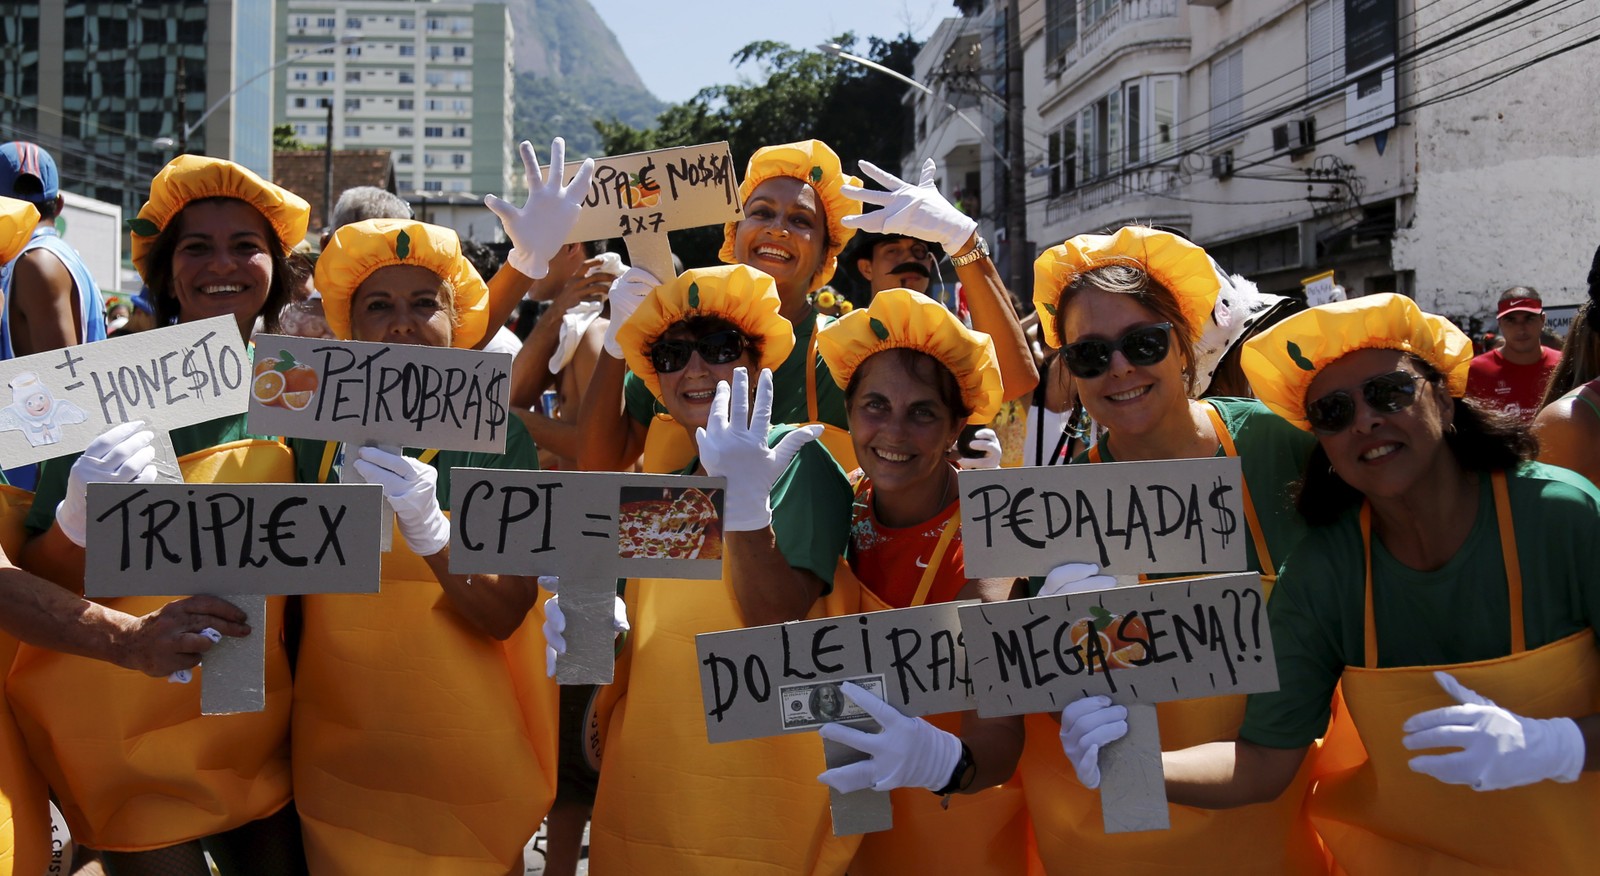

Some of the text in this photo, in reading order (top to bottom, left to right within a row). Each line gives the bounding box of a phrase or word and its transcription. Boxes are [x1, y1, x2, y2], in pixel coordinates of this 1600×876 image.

[460, 480, 563, 553] CPI
[992, 614, 1117, 693] MEGA
[49, 839, 62, 876] CRIS
